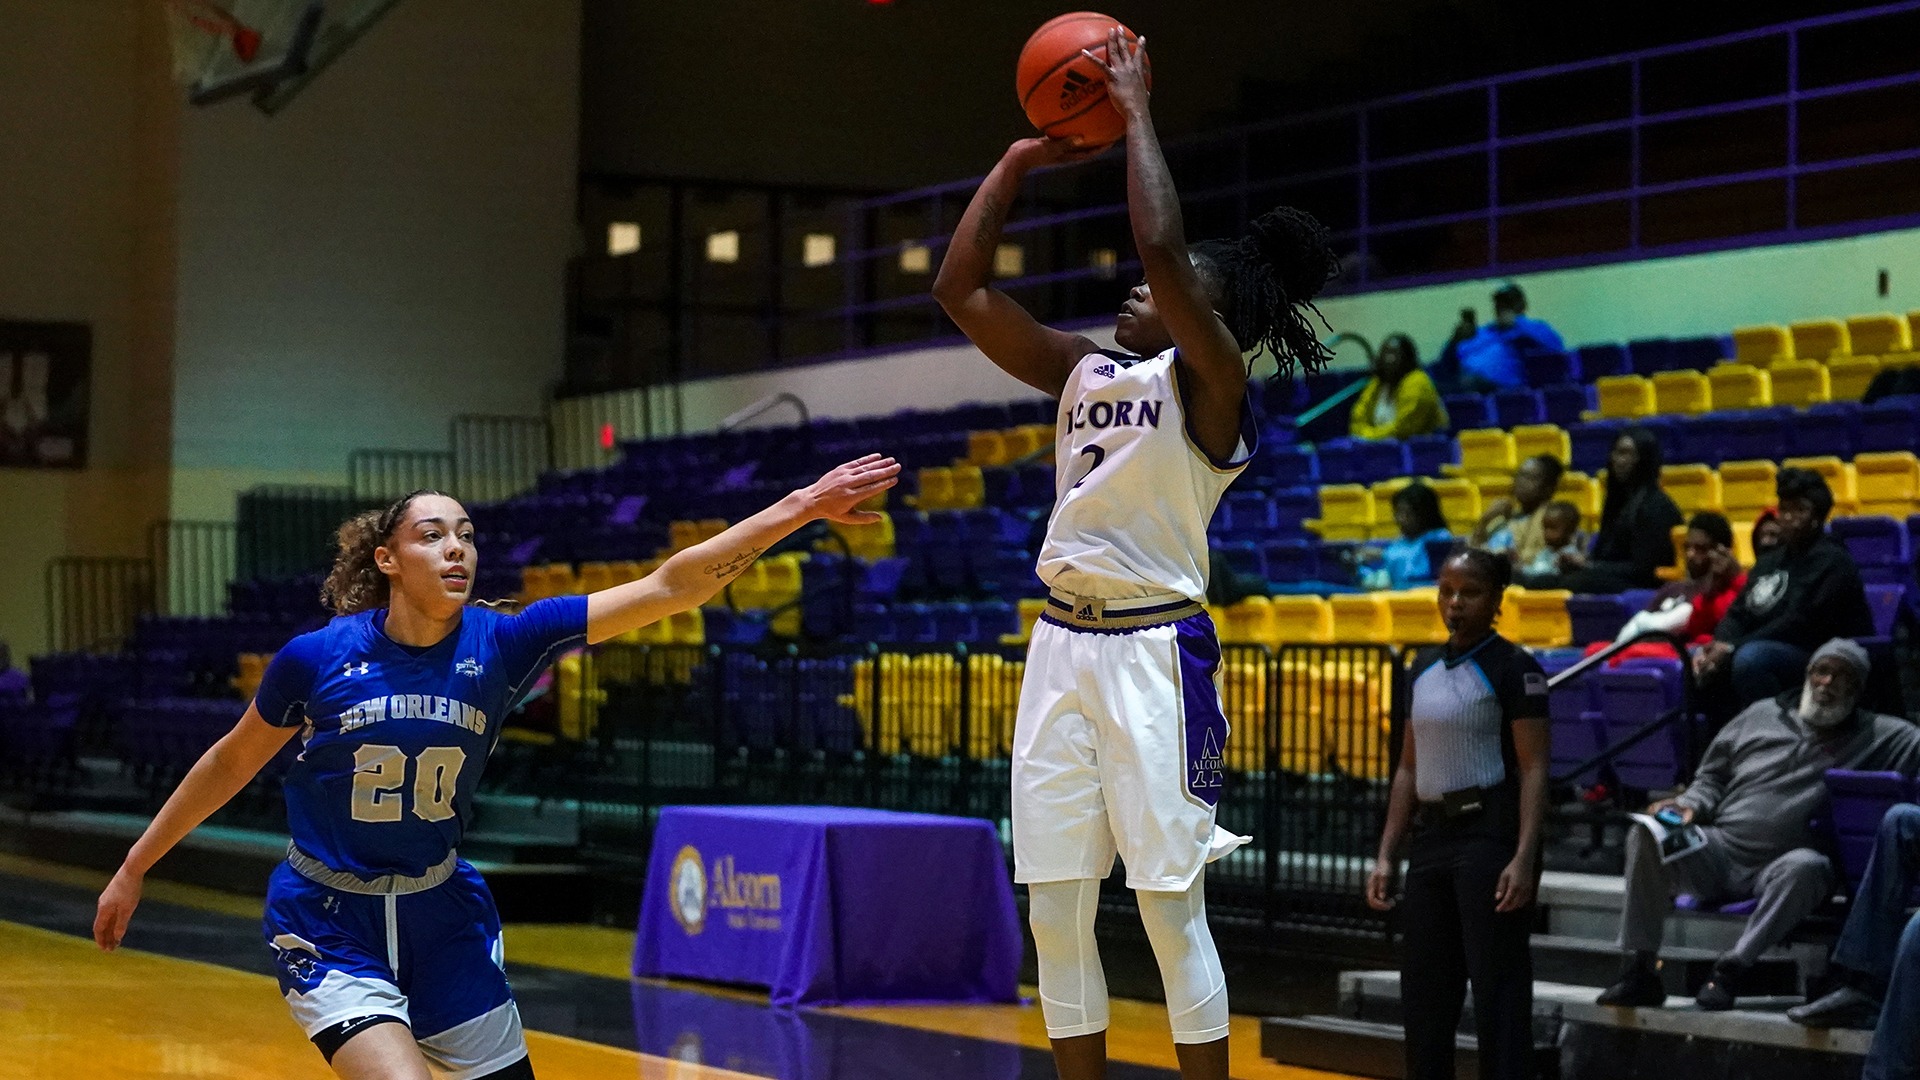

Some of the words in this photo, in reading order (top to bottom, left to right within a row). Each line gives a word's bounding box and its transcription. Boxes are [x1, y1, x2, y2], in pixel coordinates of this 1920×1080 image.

[1073, 444, 1105, 488] 2
[338, 696, 389, 735] NEW
[390, 694, 487, 735] ORLEANS
[351, 743, 467, 823] 20
[709, 854, 781, 911] Alcorn
